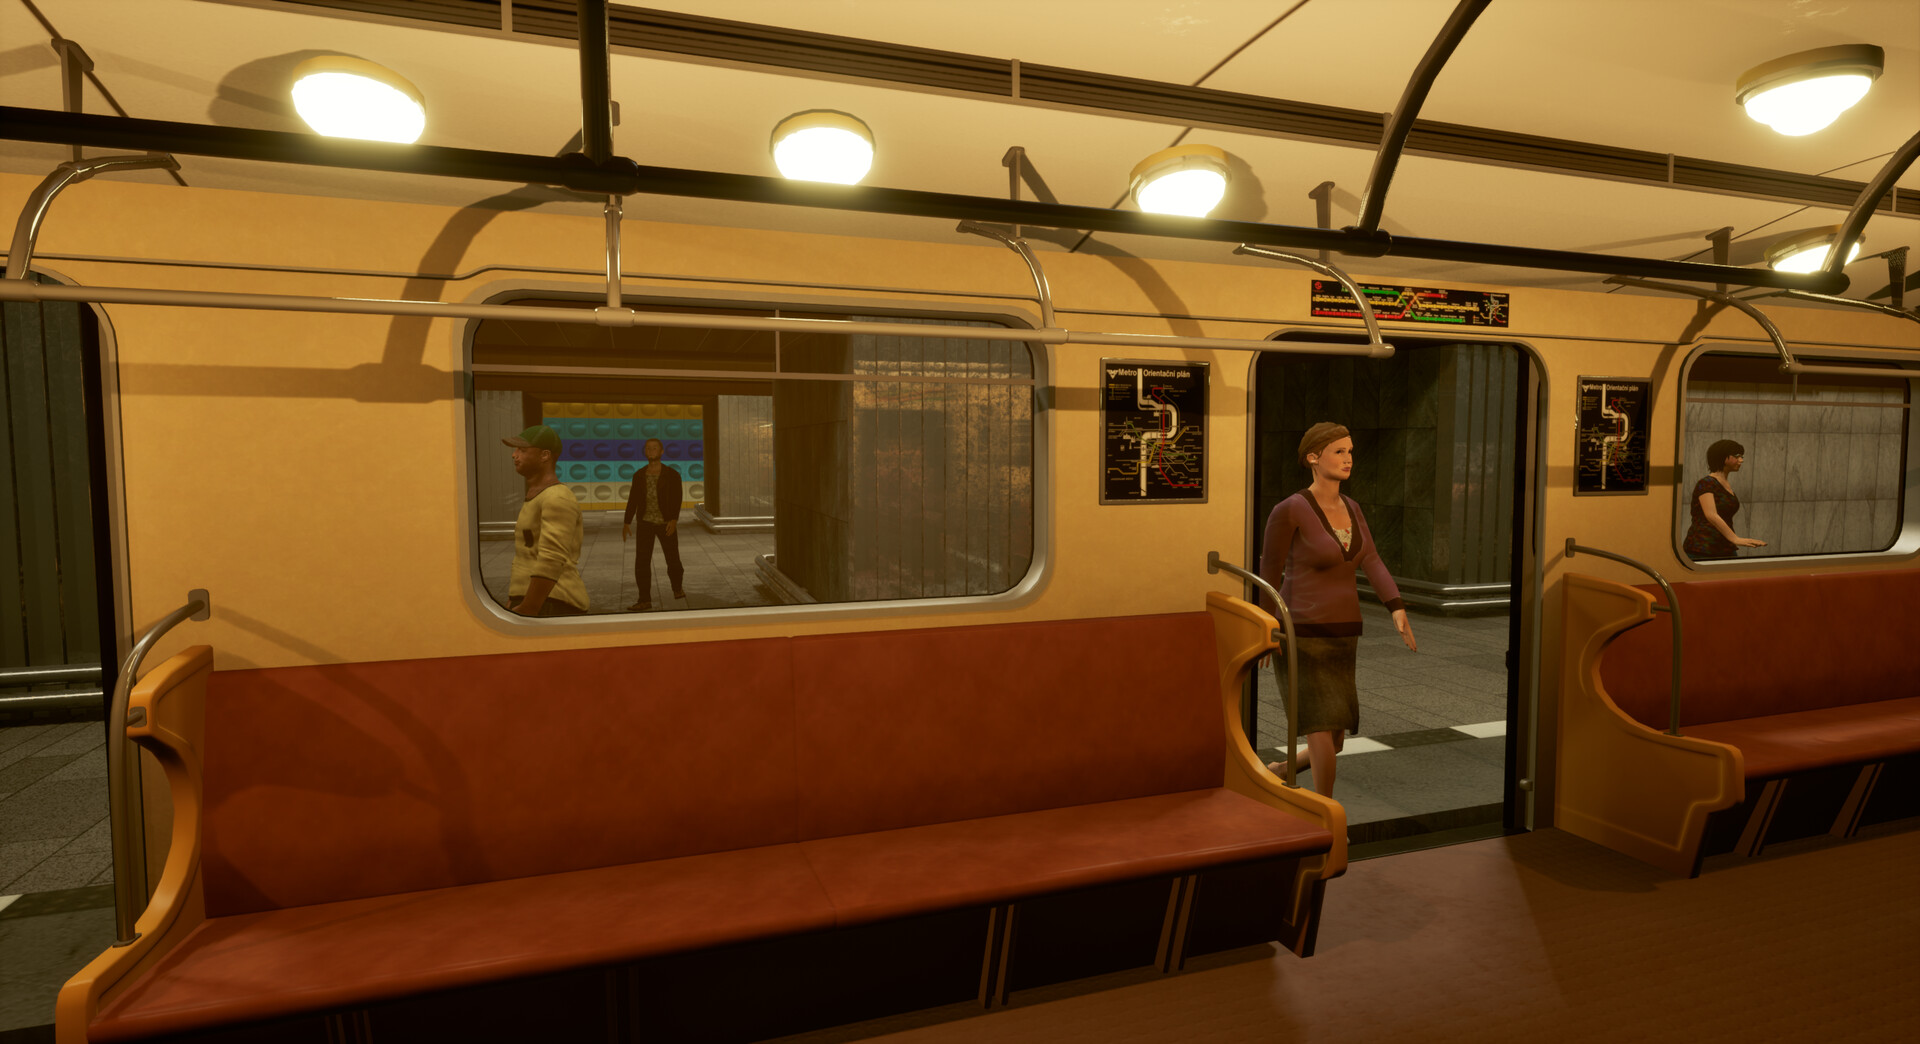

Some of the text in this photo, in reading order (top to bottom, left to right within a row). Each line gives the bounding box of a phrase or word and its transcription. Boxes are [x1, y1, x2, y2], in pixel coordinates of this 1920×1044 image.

[1118, 368, 1191, 378] Metro Orientační plán
